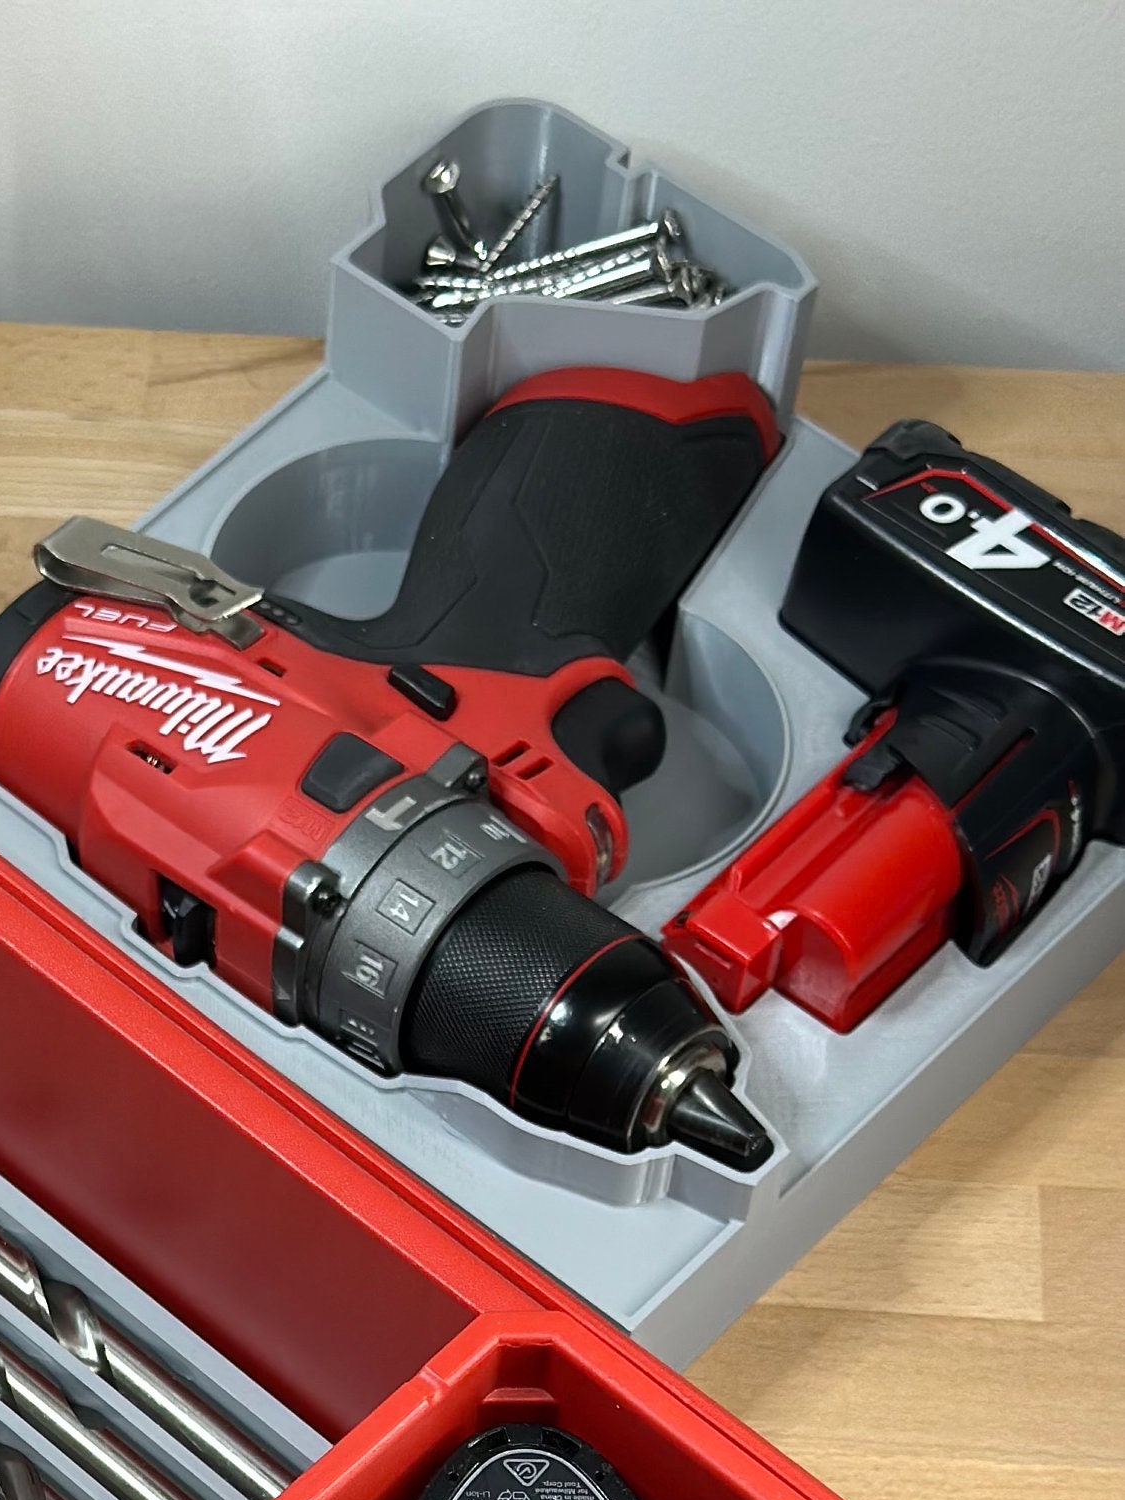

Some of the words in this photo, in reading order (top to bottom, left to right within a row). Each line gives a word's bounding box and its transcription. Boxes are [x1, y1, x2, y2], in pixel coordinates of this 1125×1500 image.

[919, 492, 1051, 569] 4.0
[75, 603, 178, 632] FUEL
[36, 647, 272, 764] Milwaukee
[430, 843, 467, 870] 12
[389, 890, 420, 922] 14
[355, 954, 384, 987] 16
